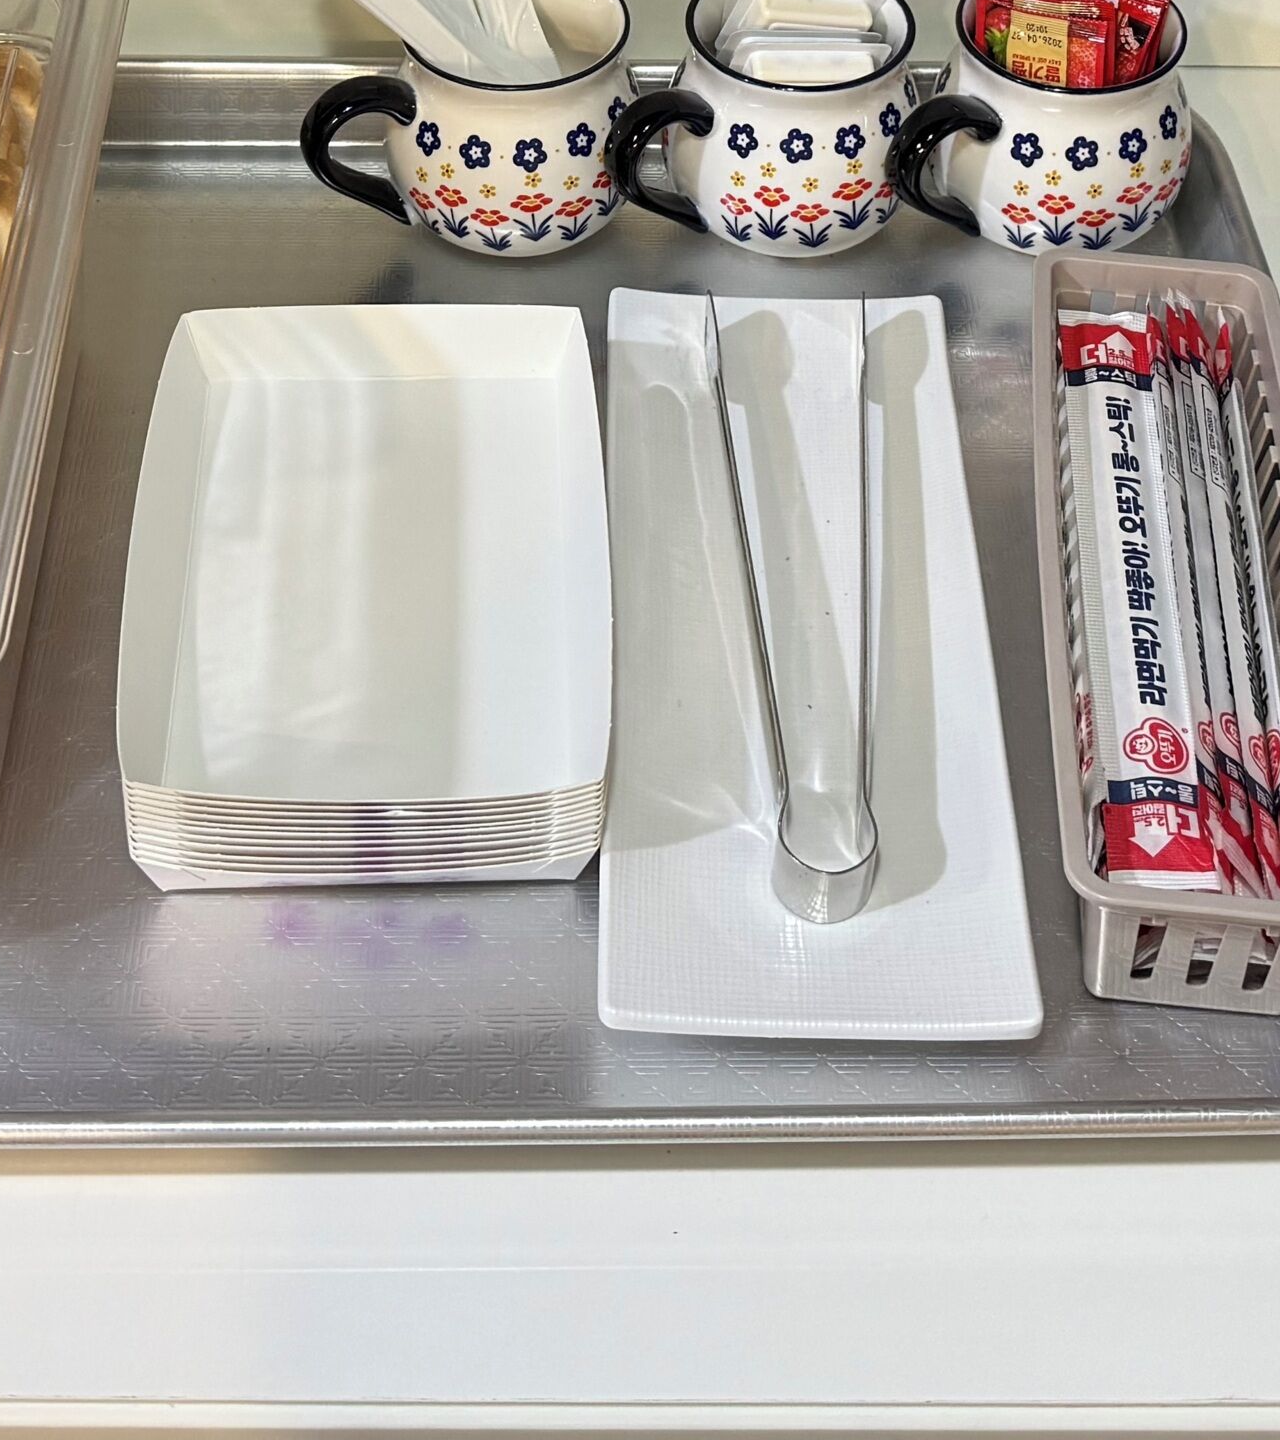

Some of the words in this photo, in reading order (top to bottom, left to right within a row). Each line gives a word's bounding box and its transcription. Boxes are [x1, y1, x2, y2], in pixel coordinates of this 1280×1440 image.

[1080, 342, 1108, 366] 더
[1084, 367, 1138, 388] 롱~스틱
[1105, 393, 1142, 474] 롱~스틱!
[1116, 477, 1148, 539] 오뚜기
[1123, 538, 1157, 612] 딱좋아!
[1131, 617, 1167, 707] 라면먹기
[1130, 779, 1195, 805] 롱~스틱
[1165, 803, 1201, 840] 더
